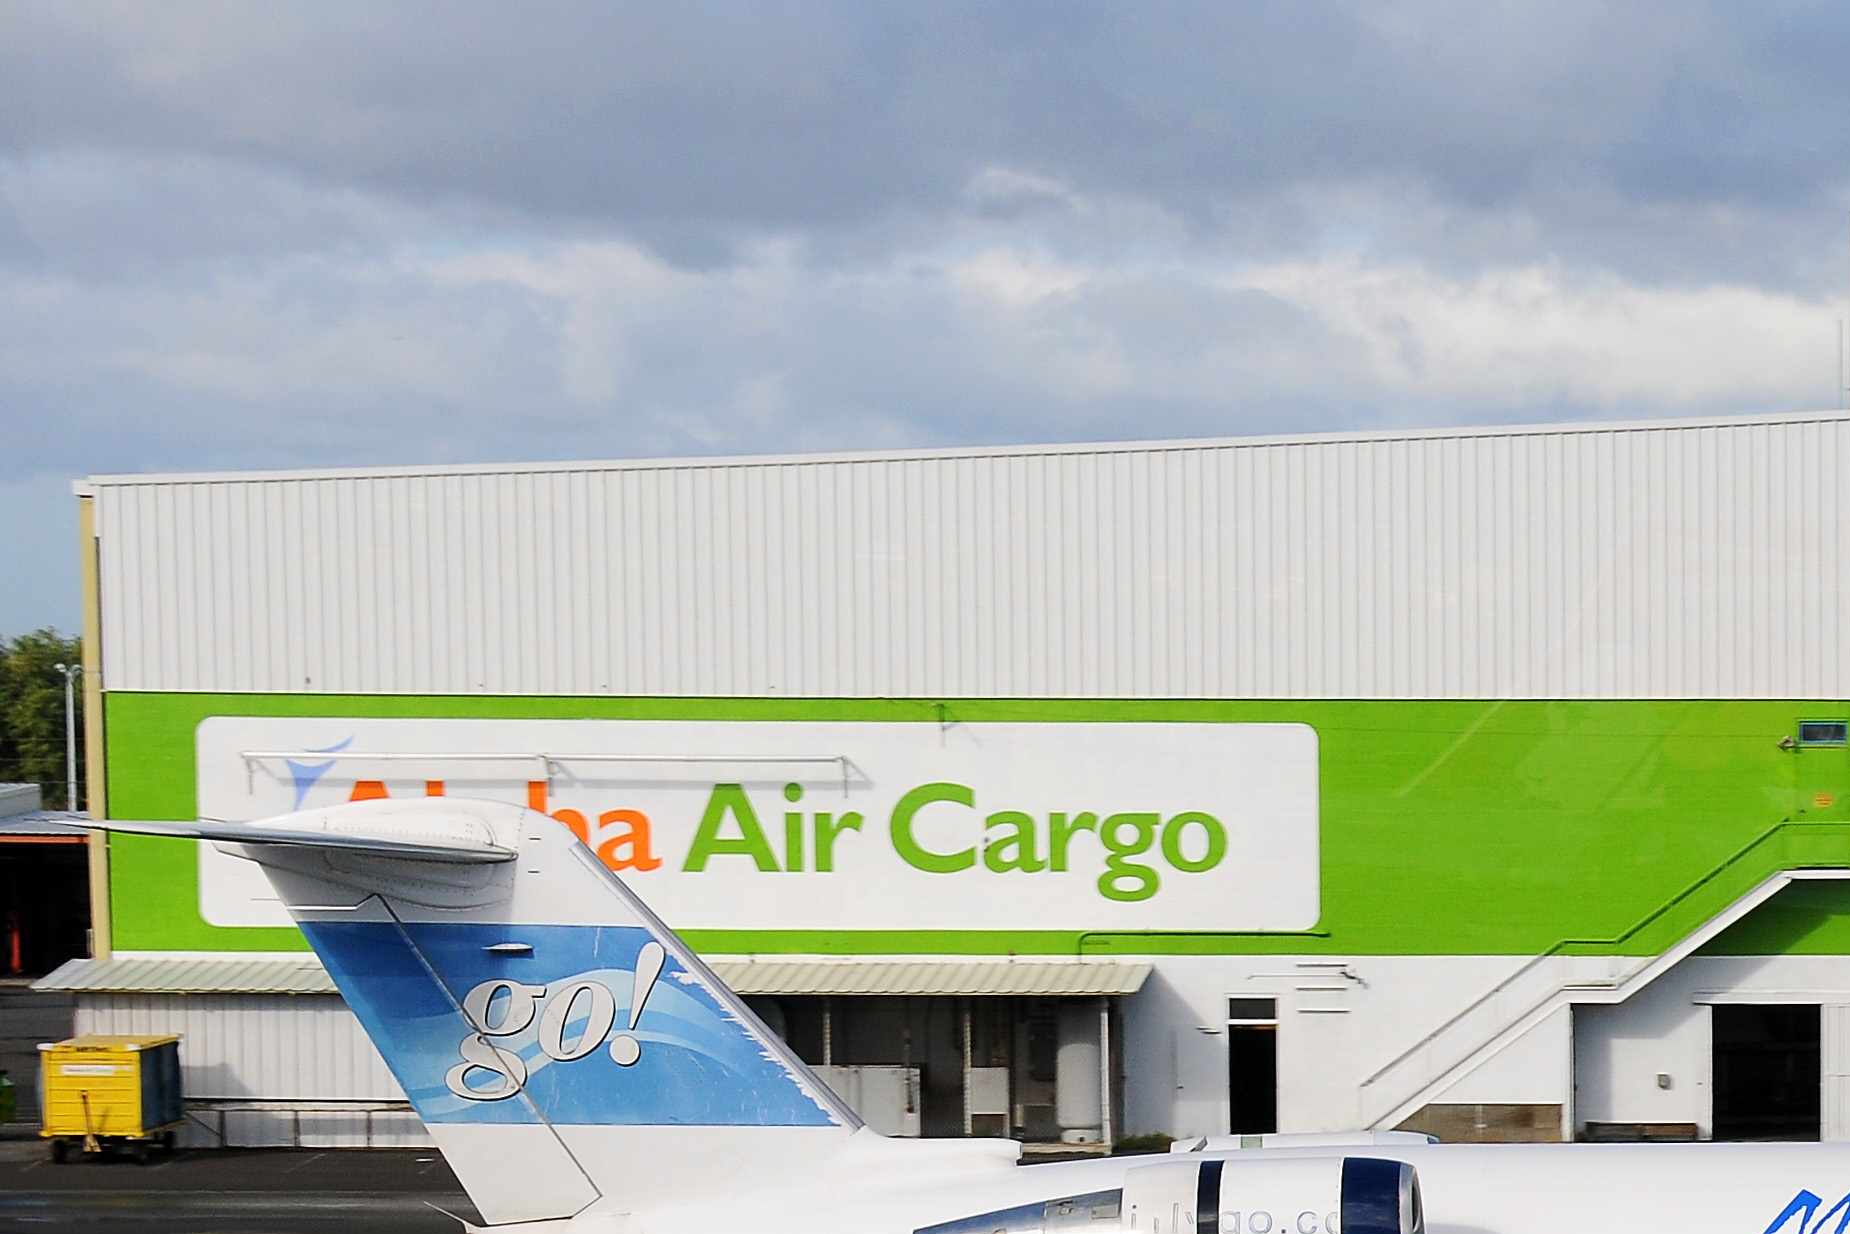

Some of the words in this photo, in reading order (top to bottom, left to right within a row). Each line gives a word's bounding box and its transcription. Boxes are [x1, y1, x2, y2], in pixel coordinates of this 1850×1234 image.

[681, 782, 863, 872] Air
[890, 781, 1228, 902] Cargo
[444, 941, 665, 1101] go!
